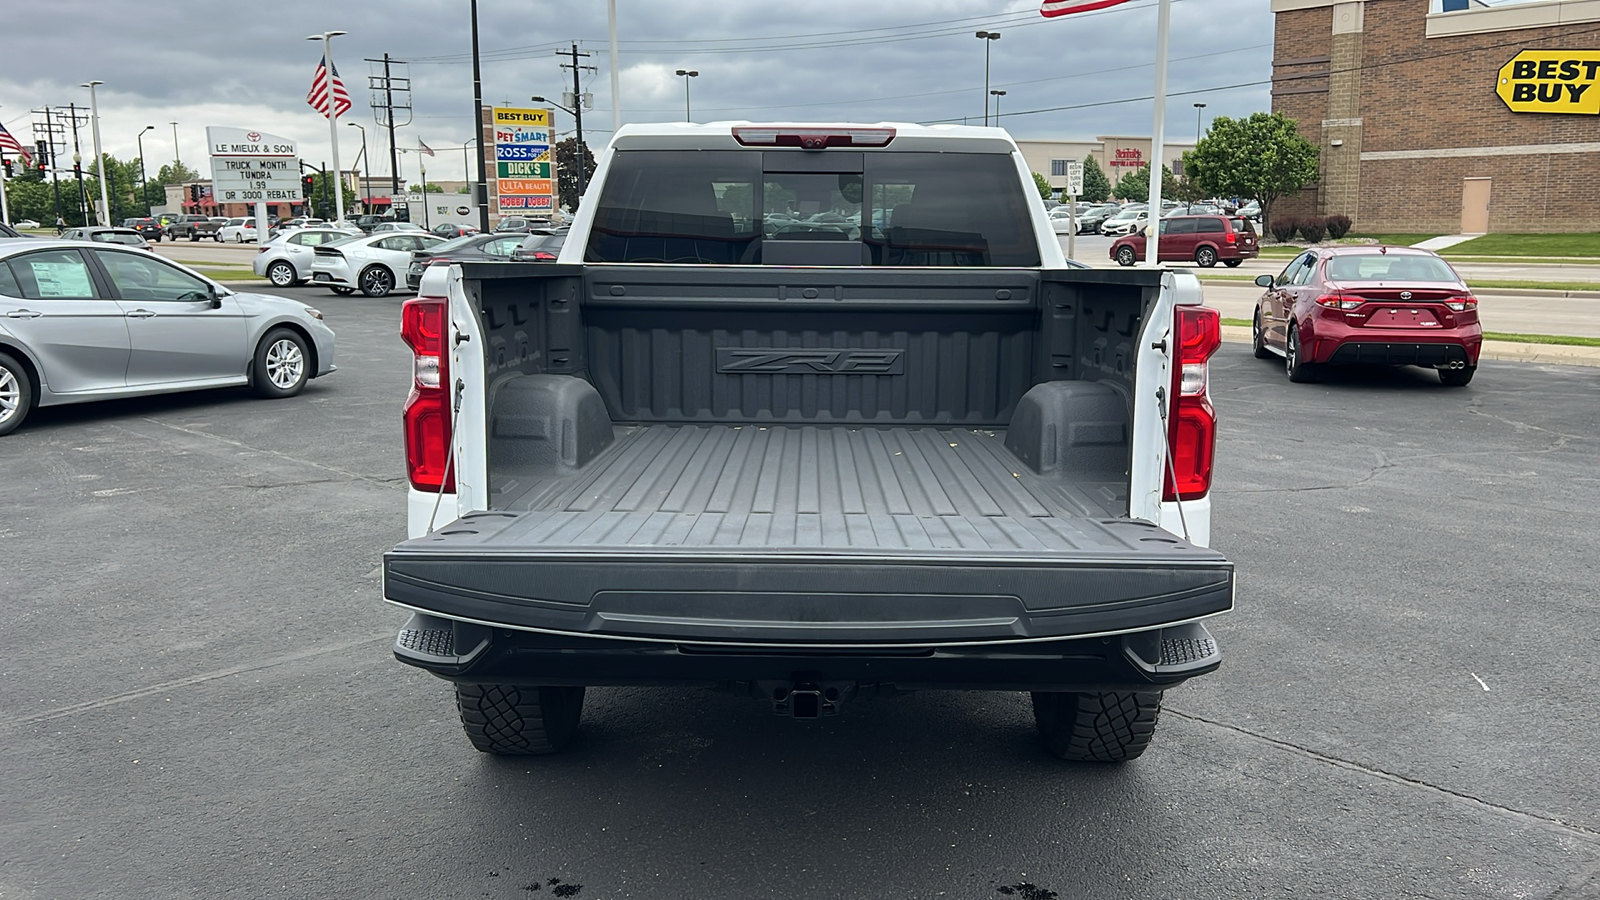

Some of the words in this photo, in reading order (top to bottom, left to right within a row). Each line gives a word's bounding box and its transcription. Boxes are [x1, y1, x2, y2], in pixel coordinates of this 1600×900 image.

[1512, 60, 1600, 80] BEST
[1512, 83, 1592, 102] BUY
[497, 112, 521, 120] BEST
[523, 113, 543, 121] BUY
[216, 144, 228, 152] LE
[231, 144, 260, 152] MIEUX
[263, 145, 269, 153] &
[273, 145, 294, 153] SON
[497, 147, 527, 158] ROSS
[225, 161, 251, 169] TRUCK
[259, 161, 287, 169] MONTH
[508, 162, 541, 174] DICK'S
[240, 171, 272, 179] TUNDRA
[249, 181, 266, 189] 1.99
[502, 181, 524, 190] ULTA
[225, 191, 236, 199] OR
[242, 191, 262, 199] 3000
[267, 190, 296, 199] REBATE
[500, 197, 526, 207] HOBBY
[527, 197, 551, 207] LOBBY
